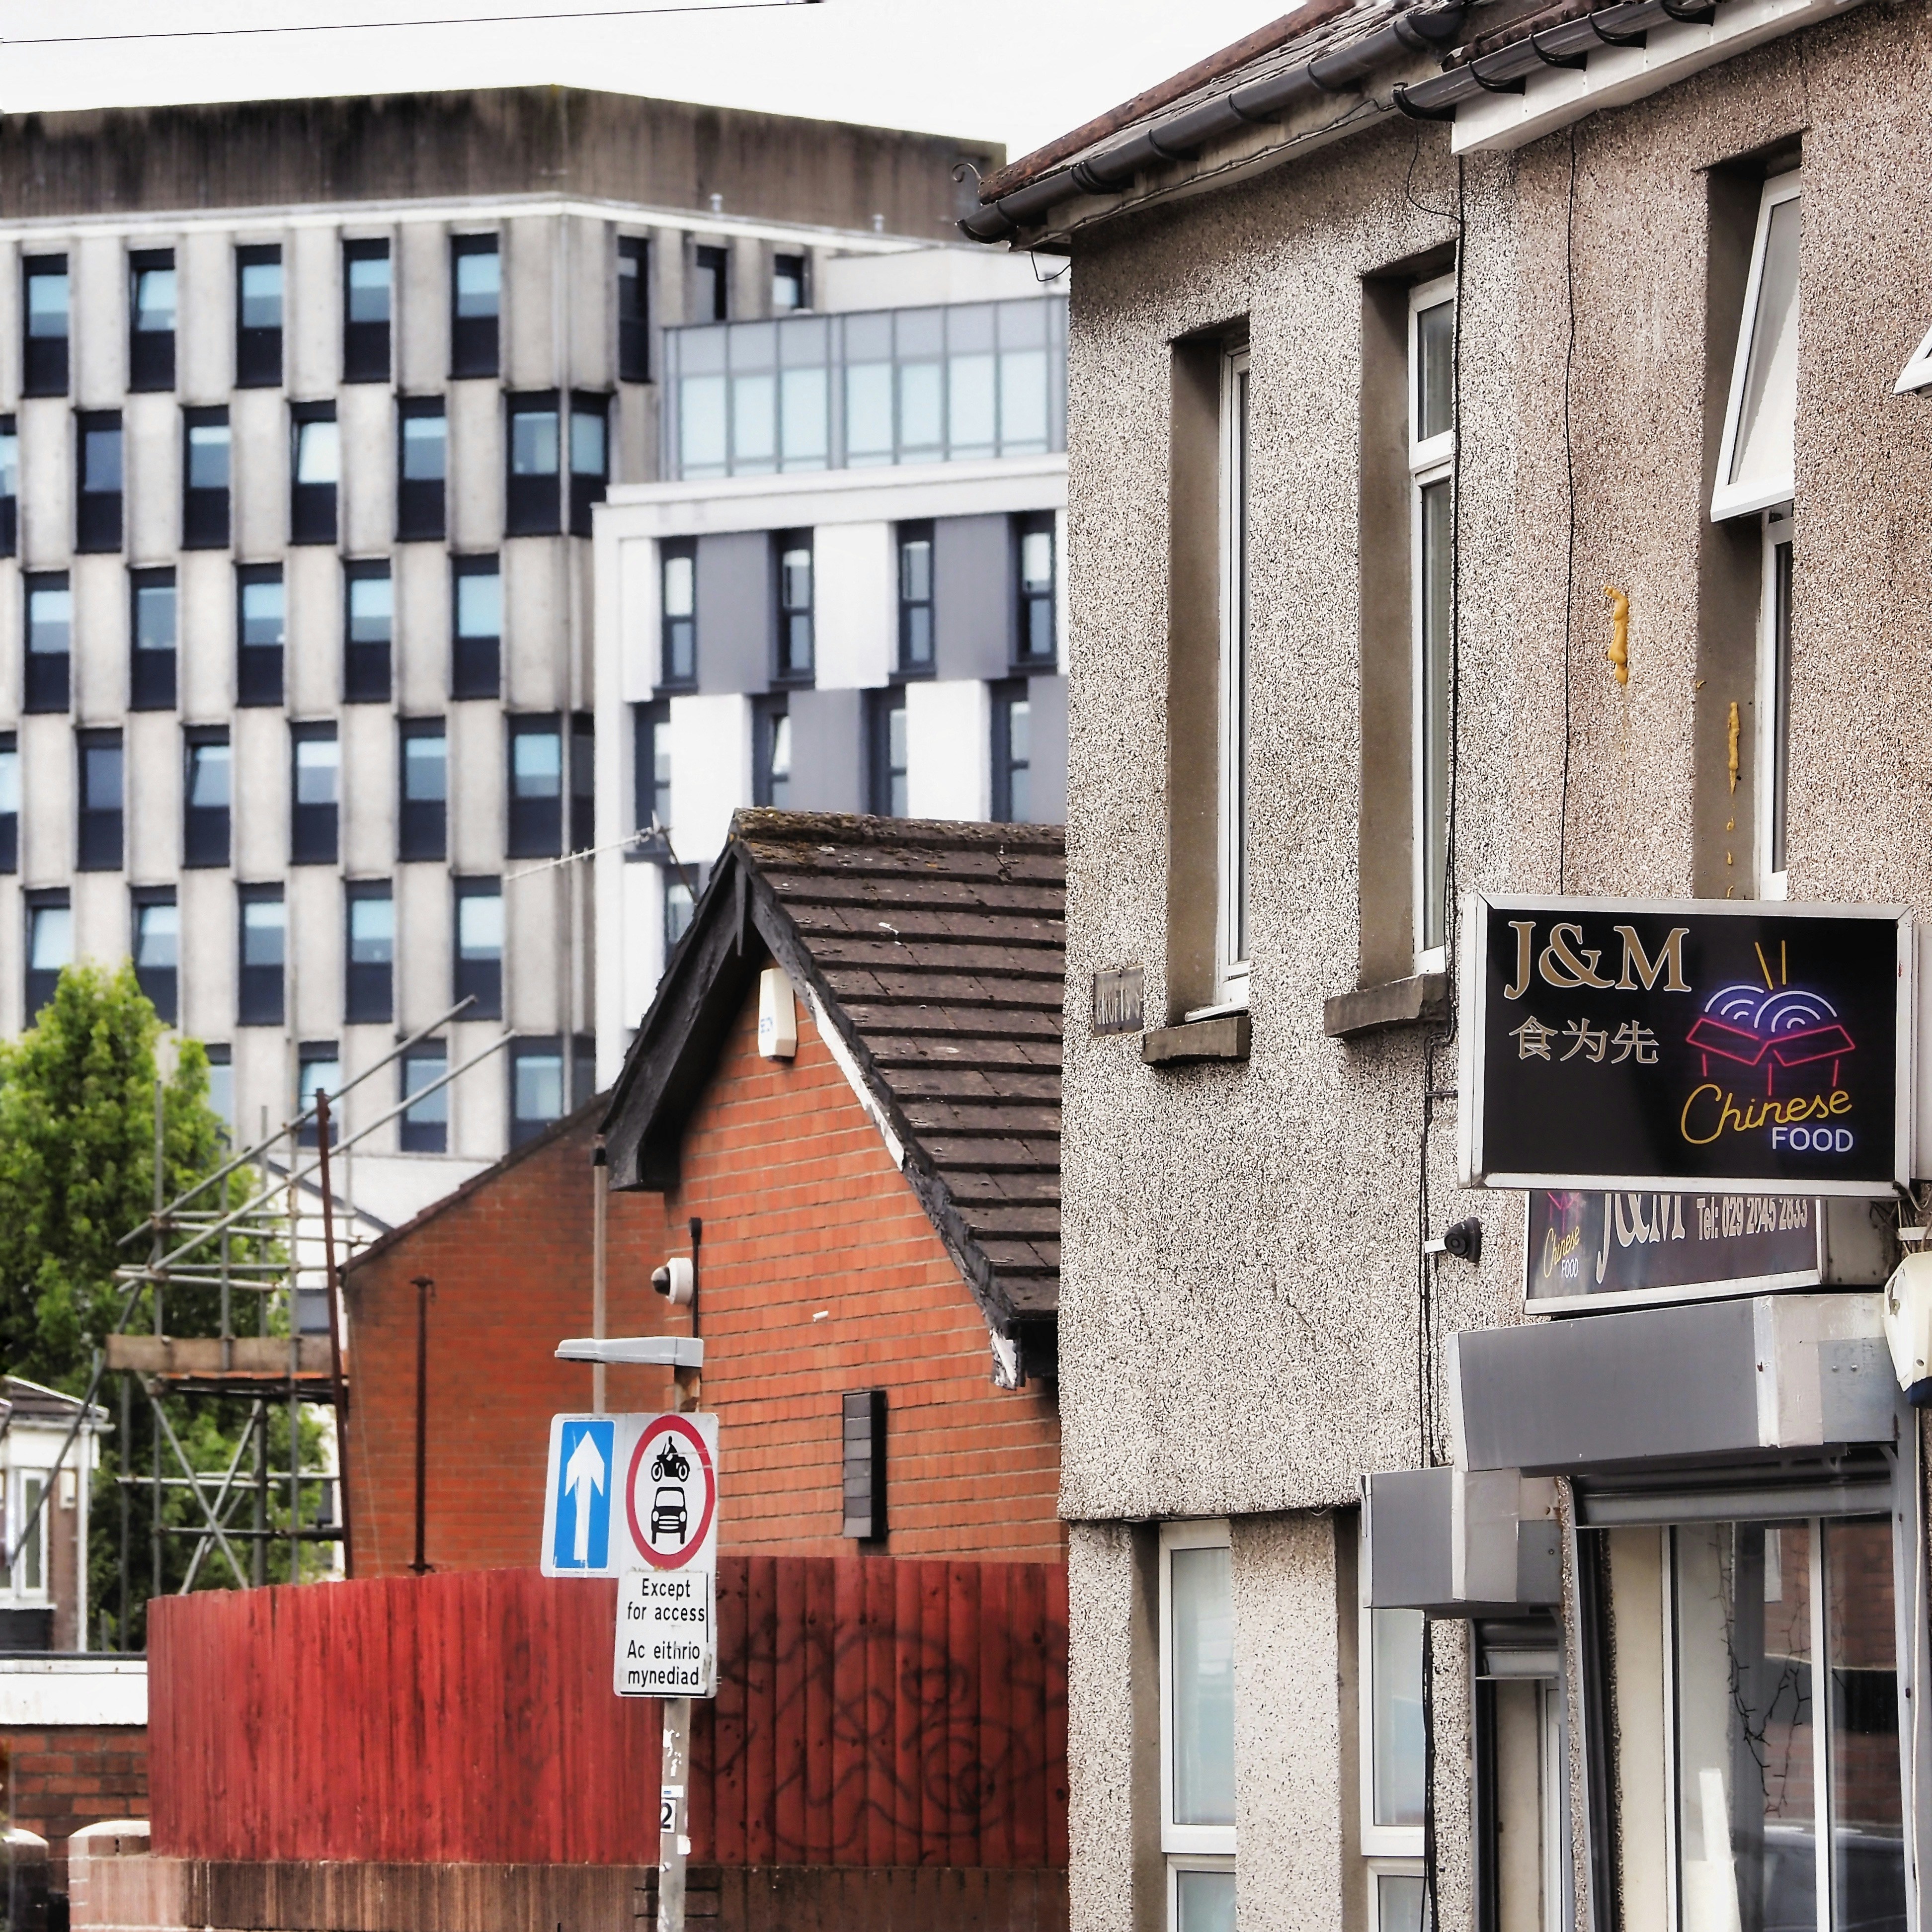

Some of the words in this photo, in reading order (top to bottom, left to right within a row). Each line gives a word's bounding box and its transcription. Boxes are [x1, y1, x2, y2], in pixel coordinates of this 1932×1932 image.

[1504, 921, 1692, 1000] J&M
[1509, 1015, 1659, 1064] 食为先
[1681, 1083, 1852, 1144] Chinese
[1771, 1126, 1854, 1152] FOOD
[1696, 1196, 1719, 1240] Tel:
[1722, 1196, 1744, 1238] 029
[1746, 1197, 1776, 1234] 2045
[1543, 1225, 1580, 1278] Chinese
[1561, 1257, 1579, 1279] FOOD
[642, 1578, 690, 1601] Except
[628, 1601, 647, 1620] for
[654, 1607, 705, 1622] access
[627, 1639, 645, 1658] Ac
[653, 1641, 700, 1660] eithrio
[628, 1666, 699, 1688] mynediad
